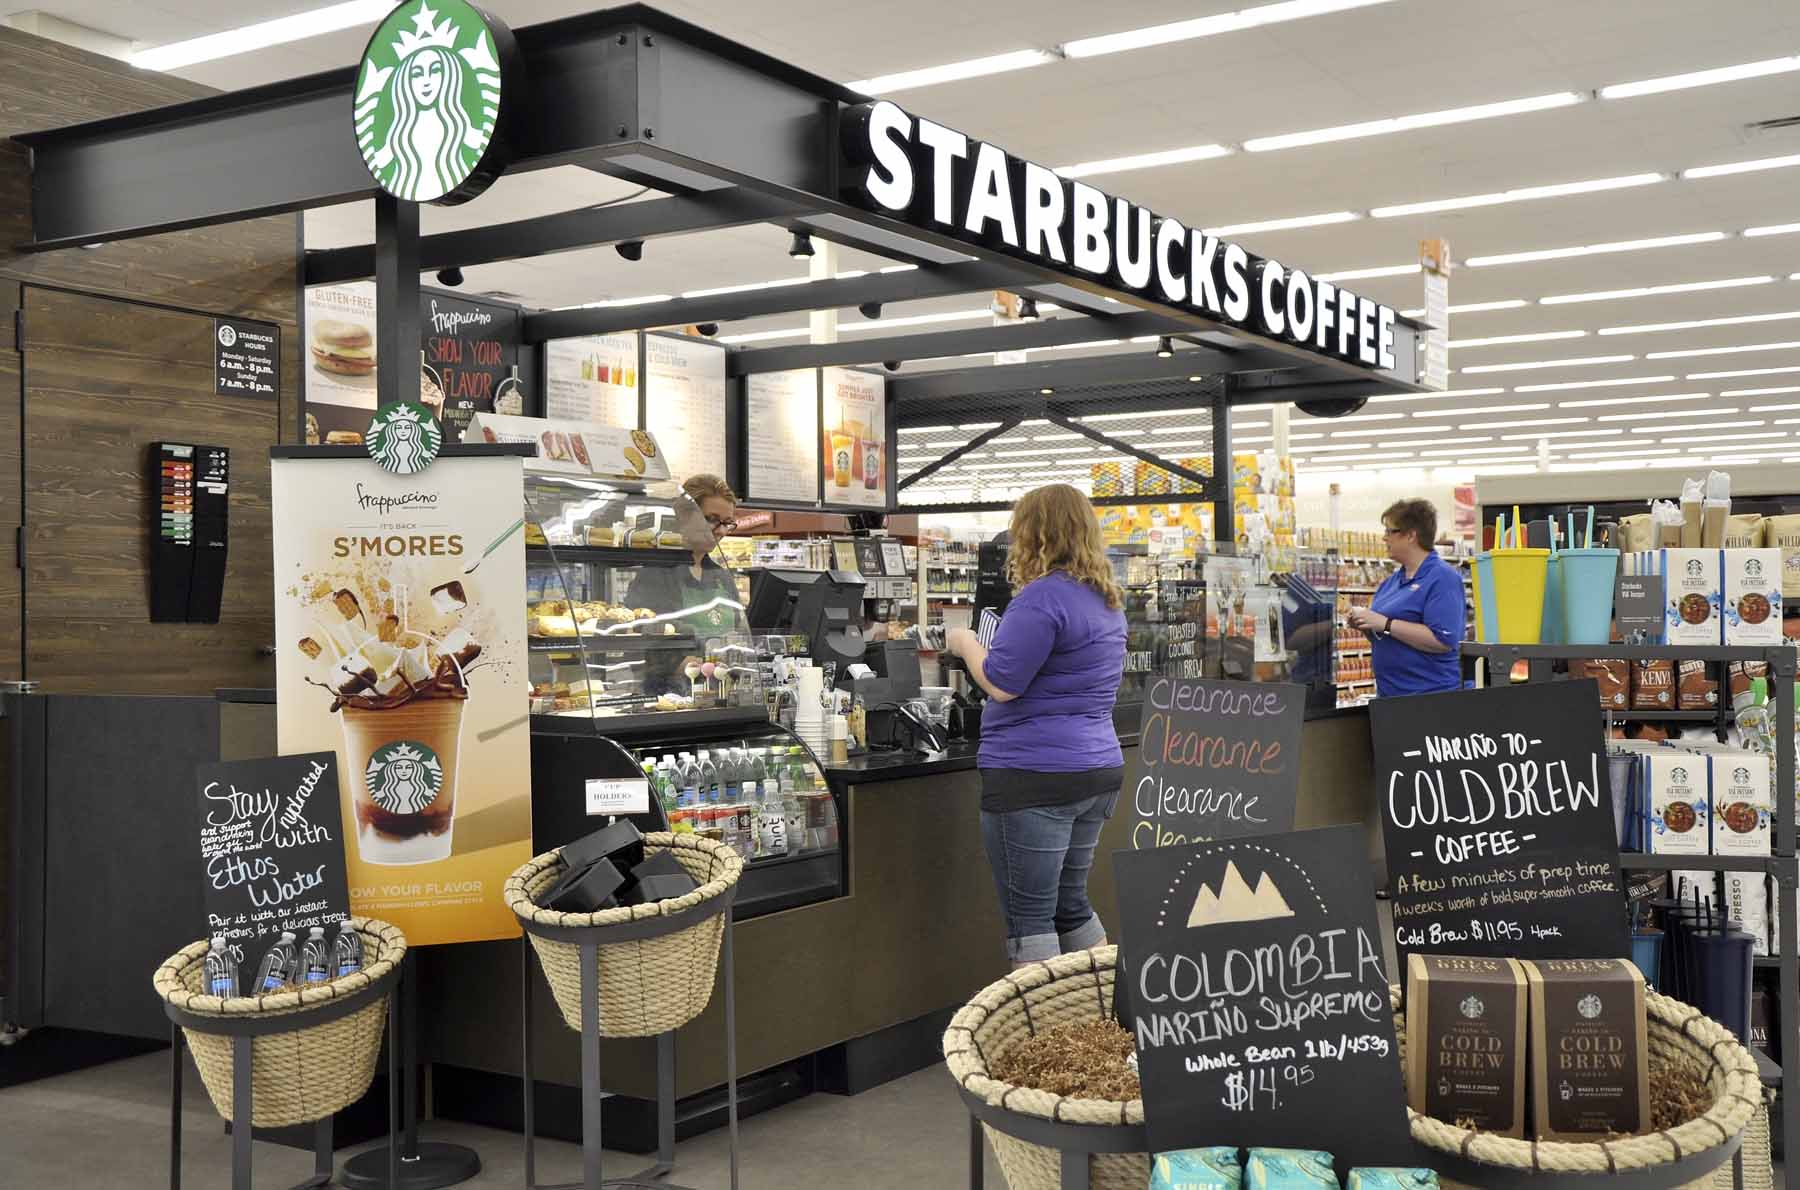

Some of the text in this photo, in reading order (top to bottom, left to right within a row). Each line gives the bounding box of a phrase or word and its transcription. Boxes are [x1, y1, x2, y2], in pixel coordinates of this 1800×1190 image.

[865, 100, 1397, 369] STARBUCKS COFFEE
[238, 331, 274, 343] STARBUCKS
[244, 342, 266, 351] HOURS
[222, 352, 245, 362] Monday
[248, 355, 272, 365] Saturday
[428, 336, 503, 365] SHOW YOUR
[220, 359, 226, 368] 6
[226, 361, 245, 370] a.m.
[249, 363, 255, 371] 8
[255, 365, 274, 375] p.m.
[237, 372, 258, 382] Sunday
[220, 377, 226, 386] 7
[226, 380, 245, 389] a.m.
[249, 381, 256, 390] 8
[255, 383, 274, 393] p.m.
[443, 367, 493, 400] FLAVOR
[356, 482, 439, 515] frappuccino
[334, 535, 464, 557] S'MORES
[1777, 536, 1800, 548] WILLO
[1168, 622, 1197, 641] TOASTED
[1168, 640, 1195, 658] COCONUT
[1183, 658, 1203, 679] BREW
[1641, 670, 1672, 686] KENYA
[1150, 678, 1288, 717] Clearance
[1142, 712, 1282, 774] Clearance
[1425, 732, 1498, 763] NARIÑO
[1135, 775, 1268, 824] Clearance
[1389, 753, 1600, 829] COLD BREW
[204, 781, 279, 842] Stay
[275, 824, 333, 848] with
[769, 816, 783, 848] hint
[1435, 830, 1521, 864] COFFEE
[207, 855, 280, 889] Ethos
[1397, 876, 1409, 895] A
[1411, 875, 1446, 893] few
[1520, 863, 1536, 880] of
[1539, 866, 1573, 887] prep
[247, 864, 327, 907] Water
[350, 880, 483, 898] OW YOUR FLAVOR
[208, 913, 231, 927] Pair
[234, 912, 248, 924] it
[251, 909, 276, 921] with
[294, 899, 328, 914] instant
[1732, 878, 1742, 925] PRESSO
[257, 922, 269, 937] for
[272, 924, 280, 933] a
[321, 911, 347, 924] treat
[1396, 926, 1424, 946] Cold
[1428, 922, 1468, 945] Brew
[1139, 926, 1389, 1002] COLOMBIA
[1135, 998, 1249, 1050] NARIÑO
[1245, 1045, 1296, 1063] Bean
[1441, 1033, 1503, 1052] COLD
[1560, 1035, 1623, 1052] COLD
[1439, 1051, 1505, 1069] BREW
[1560, 1053, 1626, 1069] BREW
